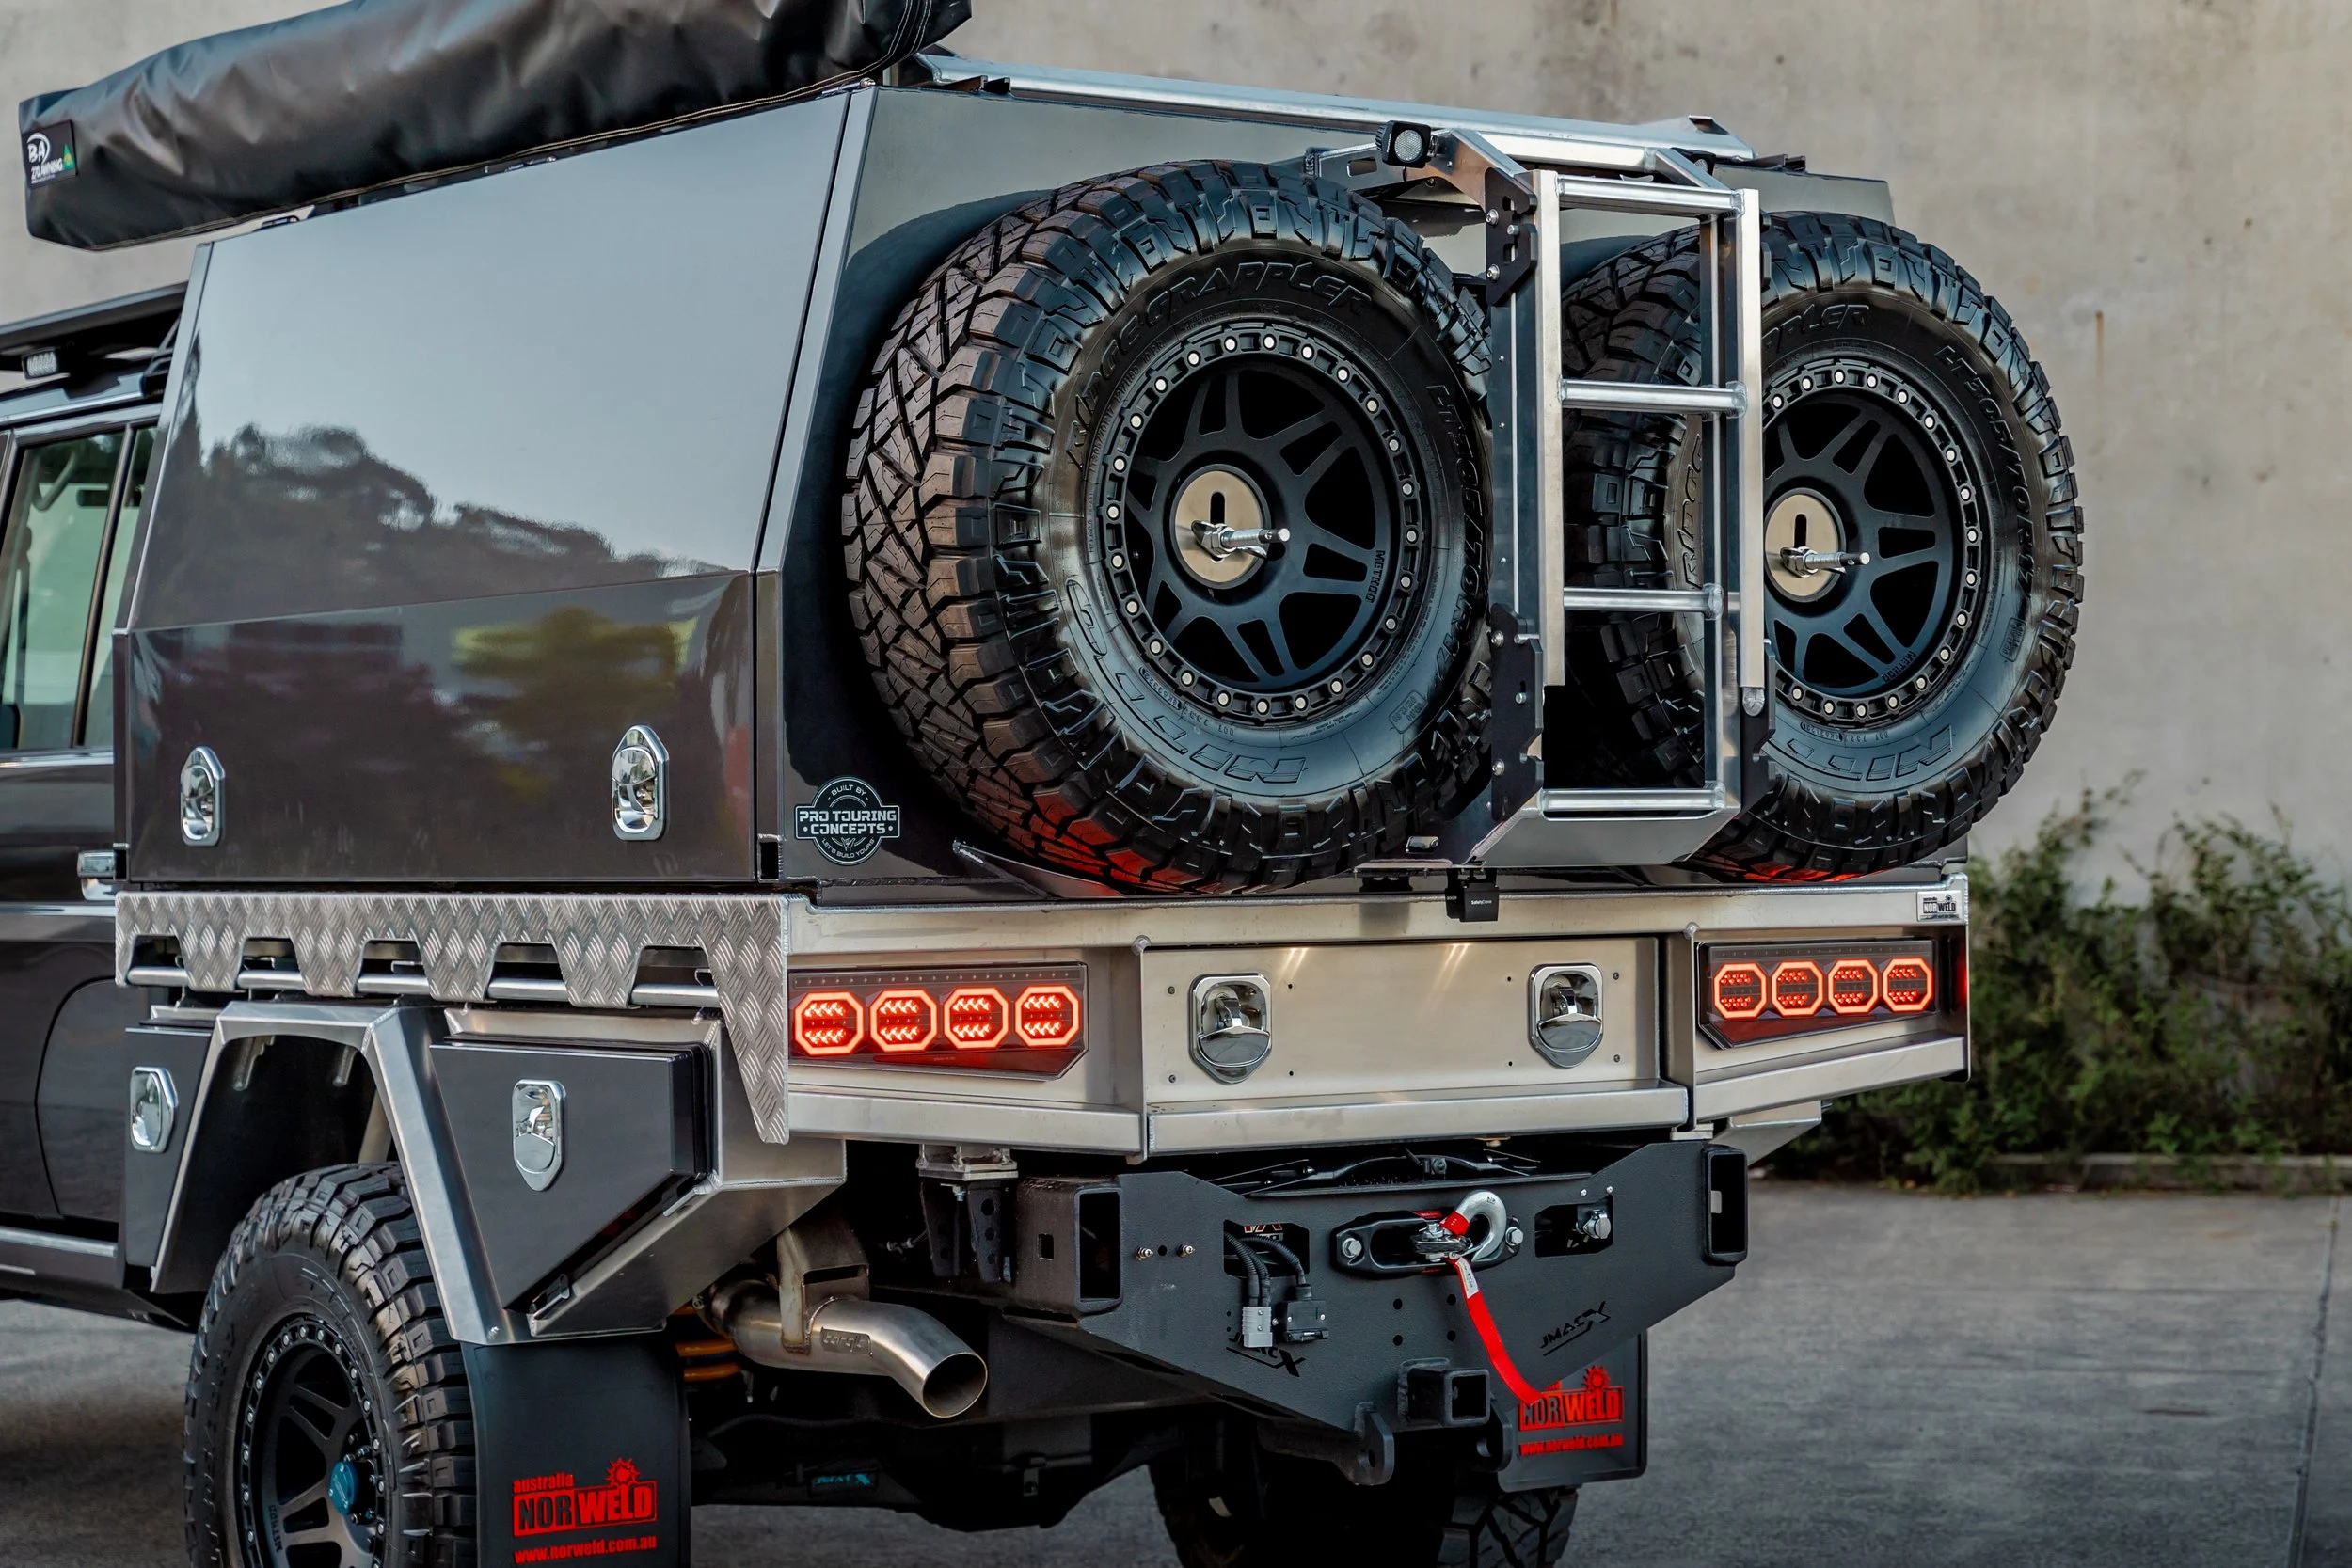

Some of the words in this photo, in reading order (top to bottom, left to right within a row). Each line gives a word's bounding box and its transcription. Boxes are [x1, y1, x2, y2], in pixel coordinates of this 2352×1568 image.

[1146, 261, 1372, 324] GRAPPLER
[1365, 549, 1386, 604] METHOD
[1066, 579, 1307, 783] NITTO
[1761, 724, 1953, 782] NITT
[831, 784, 854, 797] BUILT
[855, 786, 866, 797] BY
[800, 811, 829, 822] PRO
[833, 810, 897, 822] TOURING
[810, 823, 886, 835] CONCEPTS
[836, 850, 855, 859] BUILD
[1923, 902, 1957, 913] NORWELD
[1518, 1386, 1624, 1429] NORWELD
[513, 1472, 575, 1495] australia
[516, 1482, 656, 1535] NORWELD
[514, 1535, 658, 1565] www.norweld.com.au
